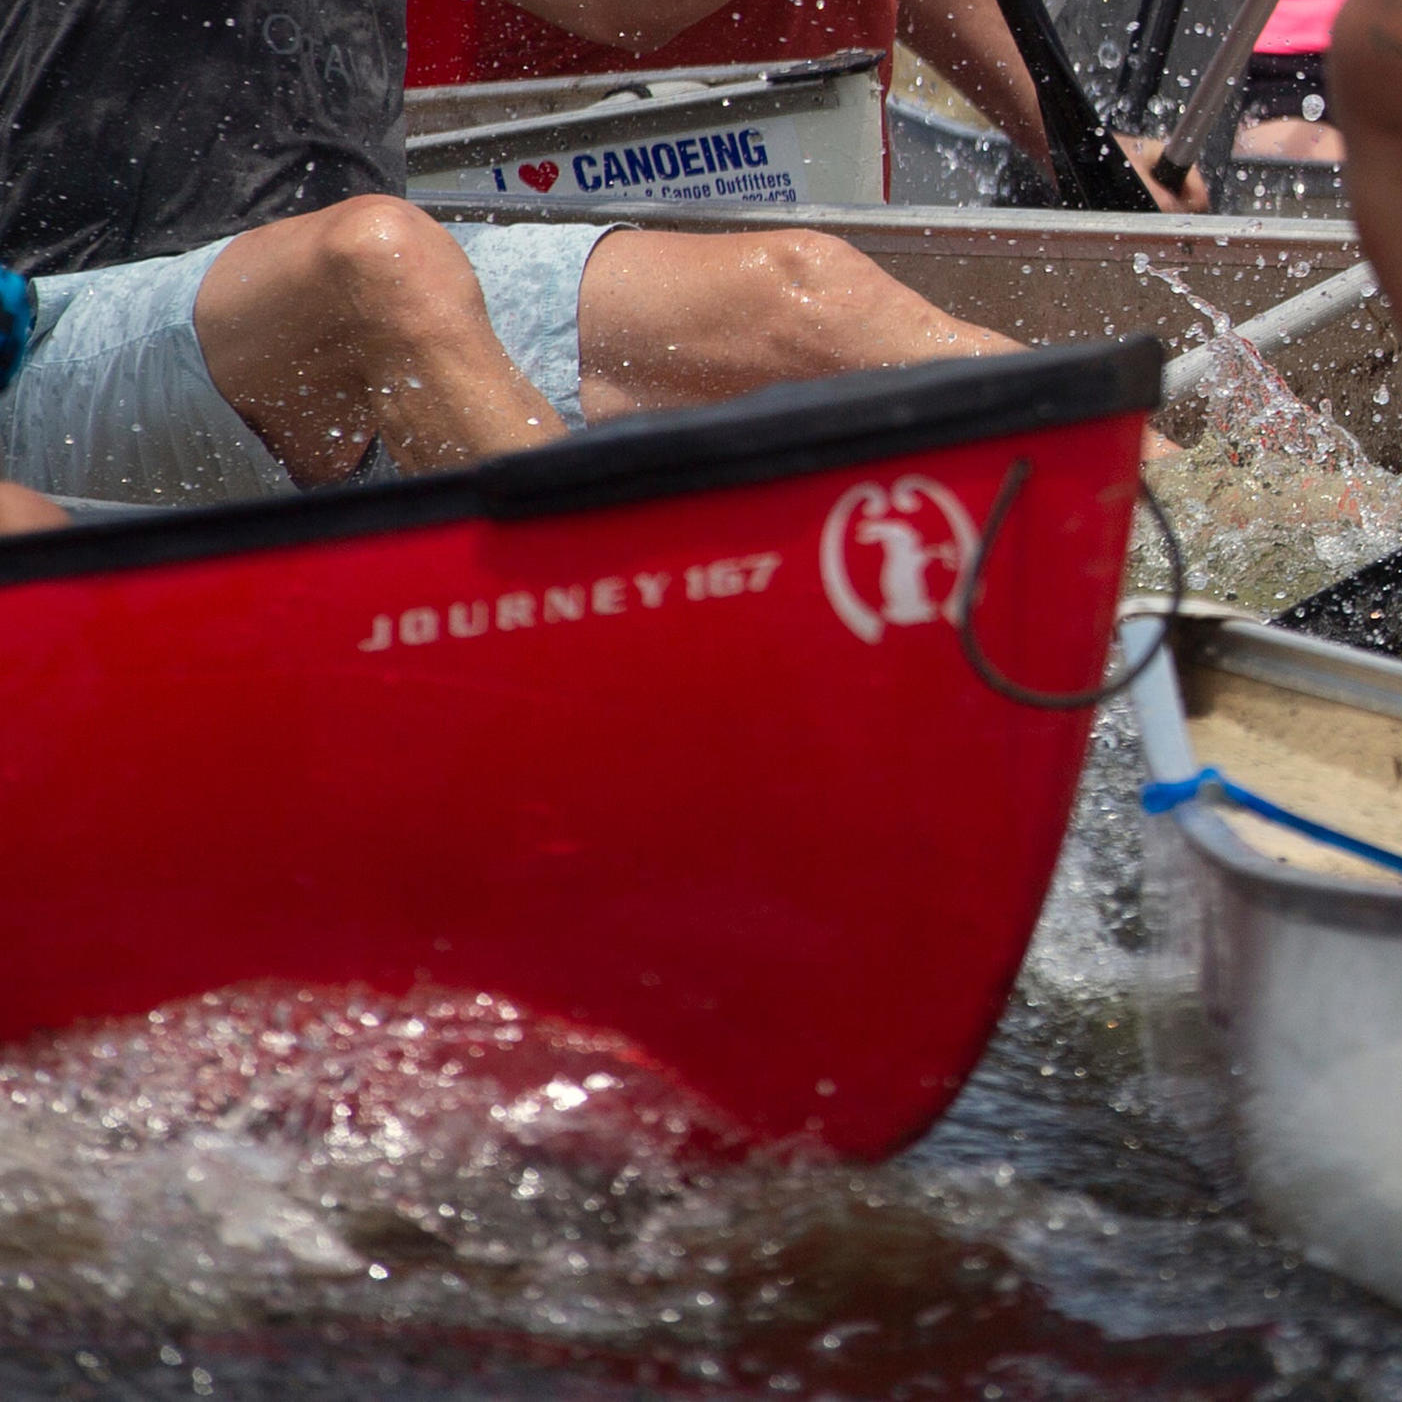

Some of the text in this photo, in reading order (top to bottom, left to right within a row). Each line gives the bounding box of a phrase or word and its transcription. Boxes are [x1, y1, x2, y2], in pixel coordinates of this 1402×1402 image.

[493, 128, 769, 193] I CANOEING
[714, 172, 792, 196] Outfitters
[357, 551, 783, 653] JOURNEY 167
